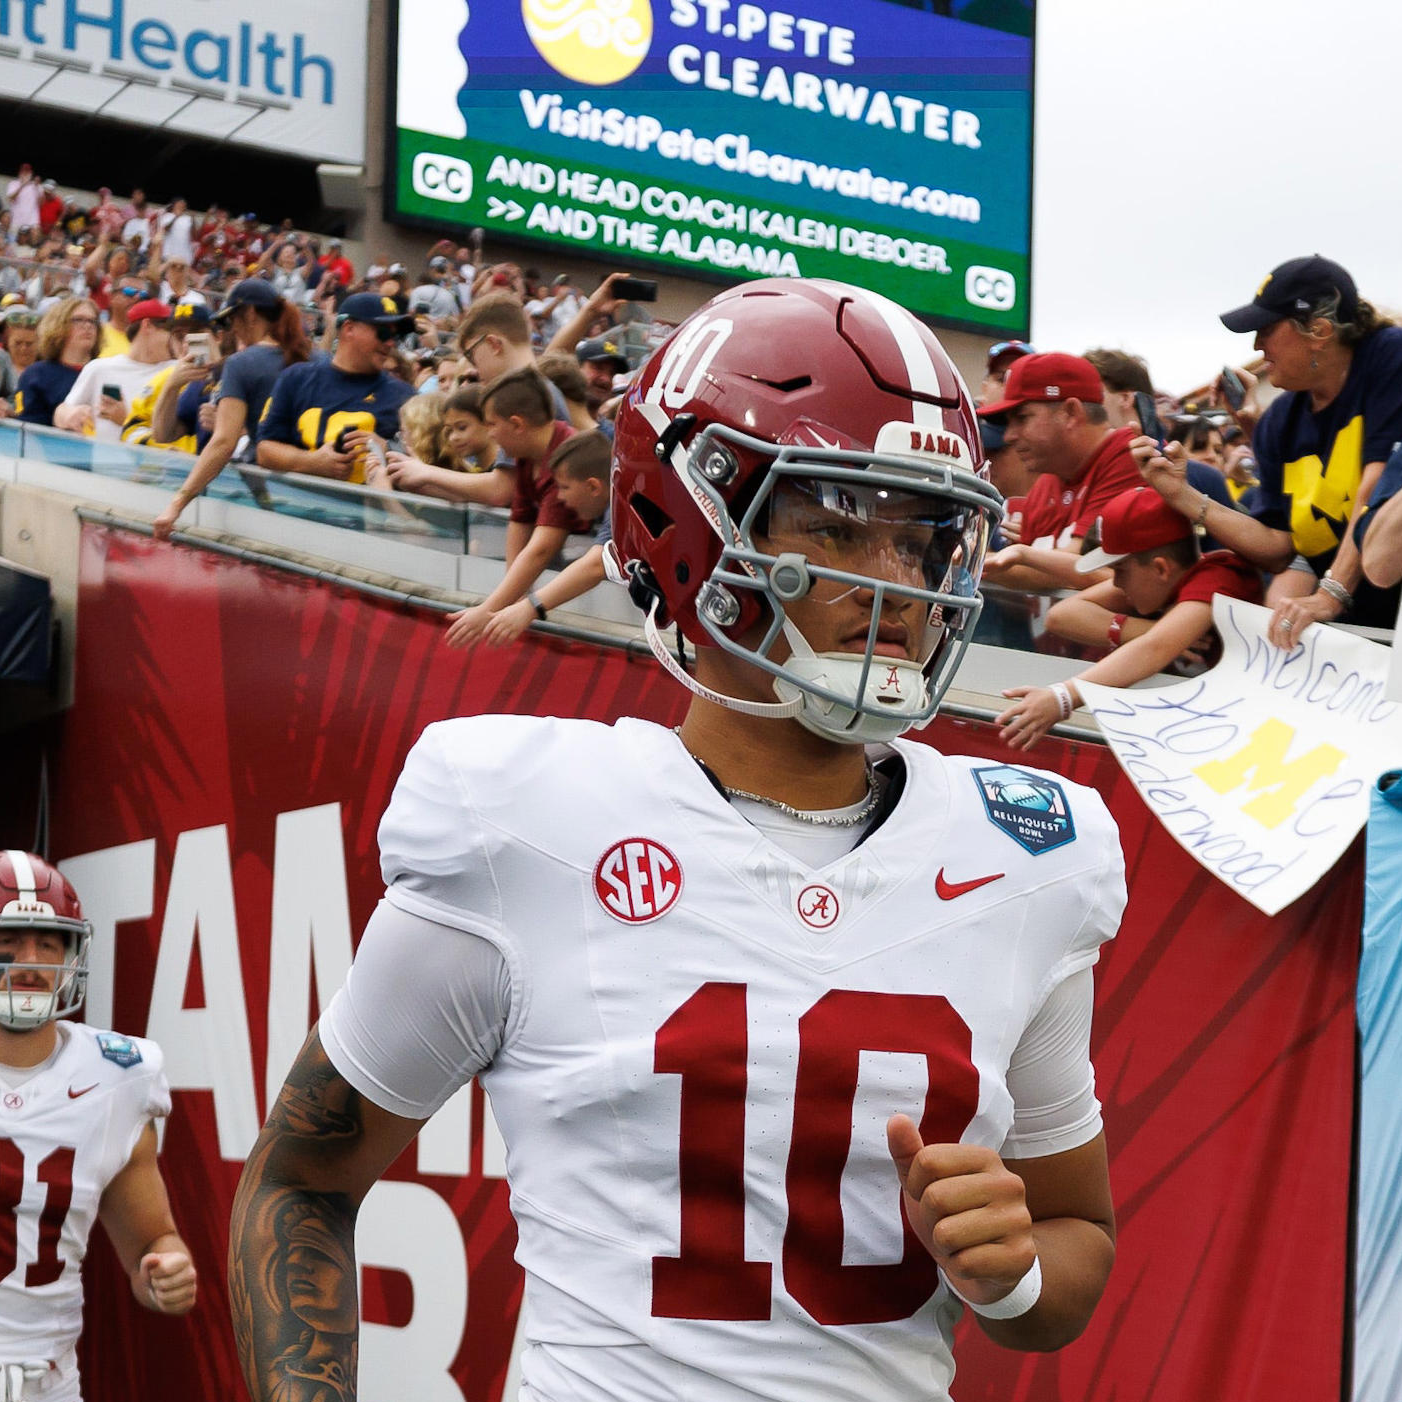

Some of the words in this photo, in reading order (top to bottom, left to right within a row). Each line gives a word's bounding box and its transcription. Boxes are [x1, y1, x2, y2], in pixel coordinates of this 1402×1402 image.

[670, 0, 856, 66] ST.PETE
[668, 45, 982, 149] CLEARWATER
[519, 90, 981, 223] VisitStPeteClearwater.com
[486, 155, 556, 195] AND
[558, 169, 640, 213] HEAD
[641, 187, 747, 233] COACH
[749, 209, 837, 252] KALEN
[527, 202, 596, 241] AND
[598, 214, 659, 253] THE
[660, 229, 801, 279] ALABAMA
[645, 314, 735, 410] 10
[910, 430, 962, 460] BAMA
[879, 666, 902, 694] A
[993, 809, 1060, 833] RELIAQUEST
[1018, 826, 1044, 839] BOWL
[599, 845, 677, 921] SEC
[651, 981, 980, 1326] 10
